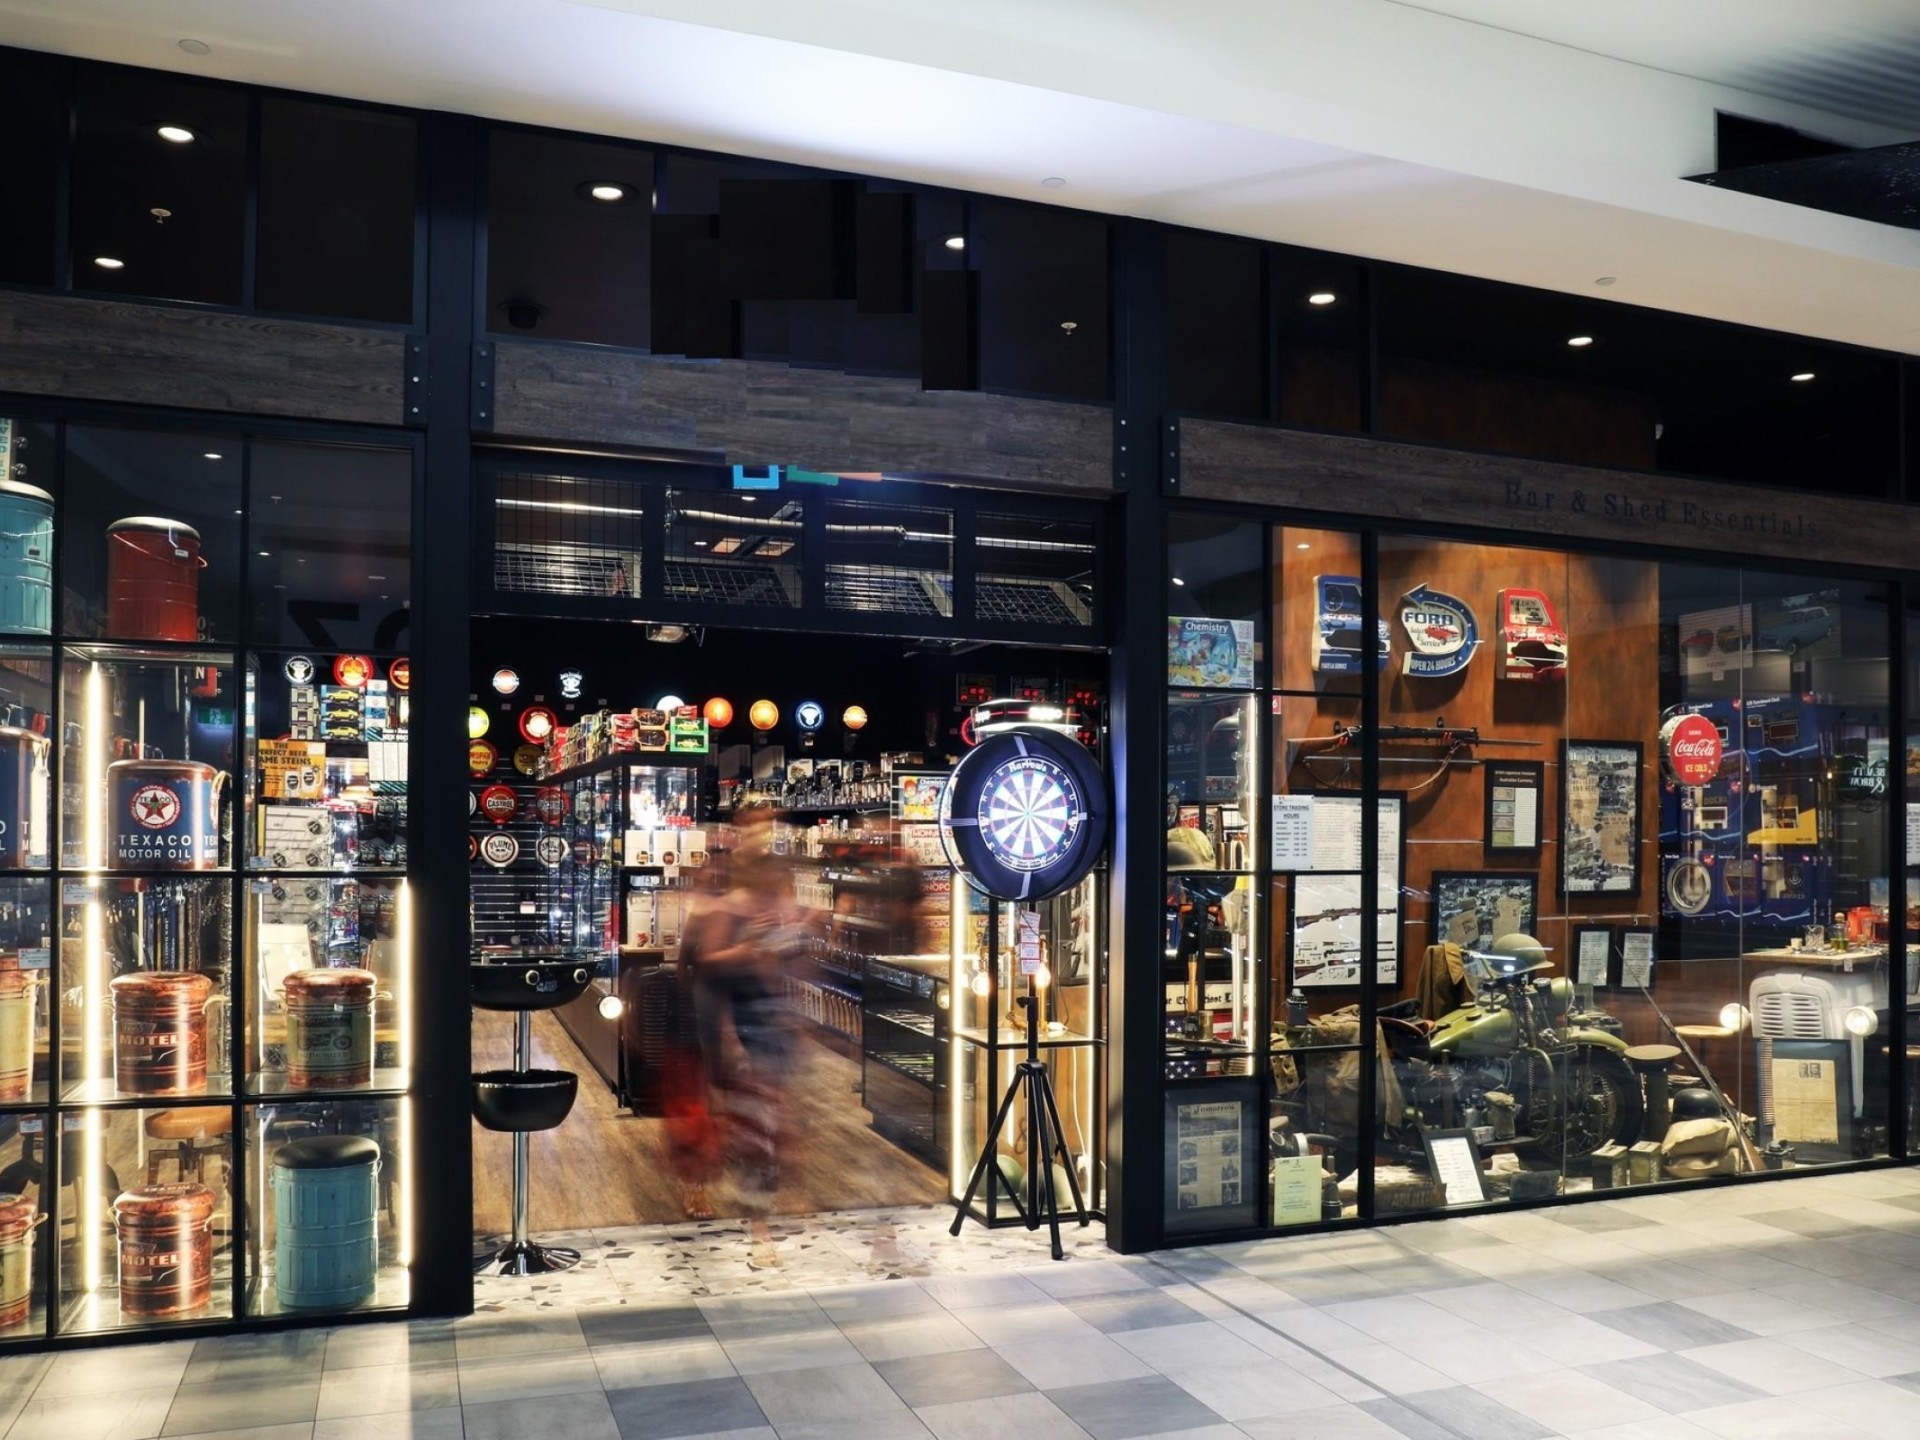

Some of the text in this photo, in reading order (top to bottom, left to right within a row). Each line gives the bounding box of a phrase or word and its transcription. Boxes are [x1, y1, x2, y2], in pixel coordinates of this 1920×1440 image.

[1504, 478, 1817, 536] Bar & Shed Essentials
[1404, 612, 1453, 625] FORD
[1185, 621, 1229, 633] Chemistry
[1411, 656, 1456, 671] OPEN 24 HOURS
[1674, 738, 1716, 757] Coca-Cola
[259, 756, 311, 765] AME STEINS
[1008, 761, 1047, 773] Harrows
[1685, 764, 1708, 773] ICE COLD
[487, 799, 514, 809] CASTROL
[118, 834, 192, 846] TEXACO
[118, 849, 191, 858] MOTOR OIL
[119, 1034, 180, 1046] MOTEL
[121, 1254, 180, 1266] MOTEL
